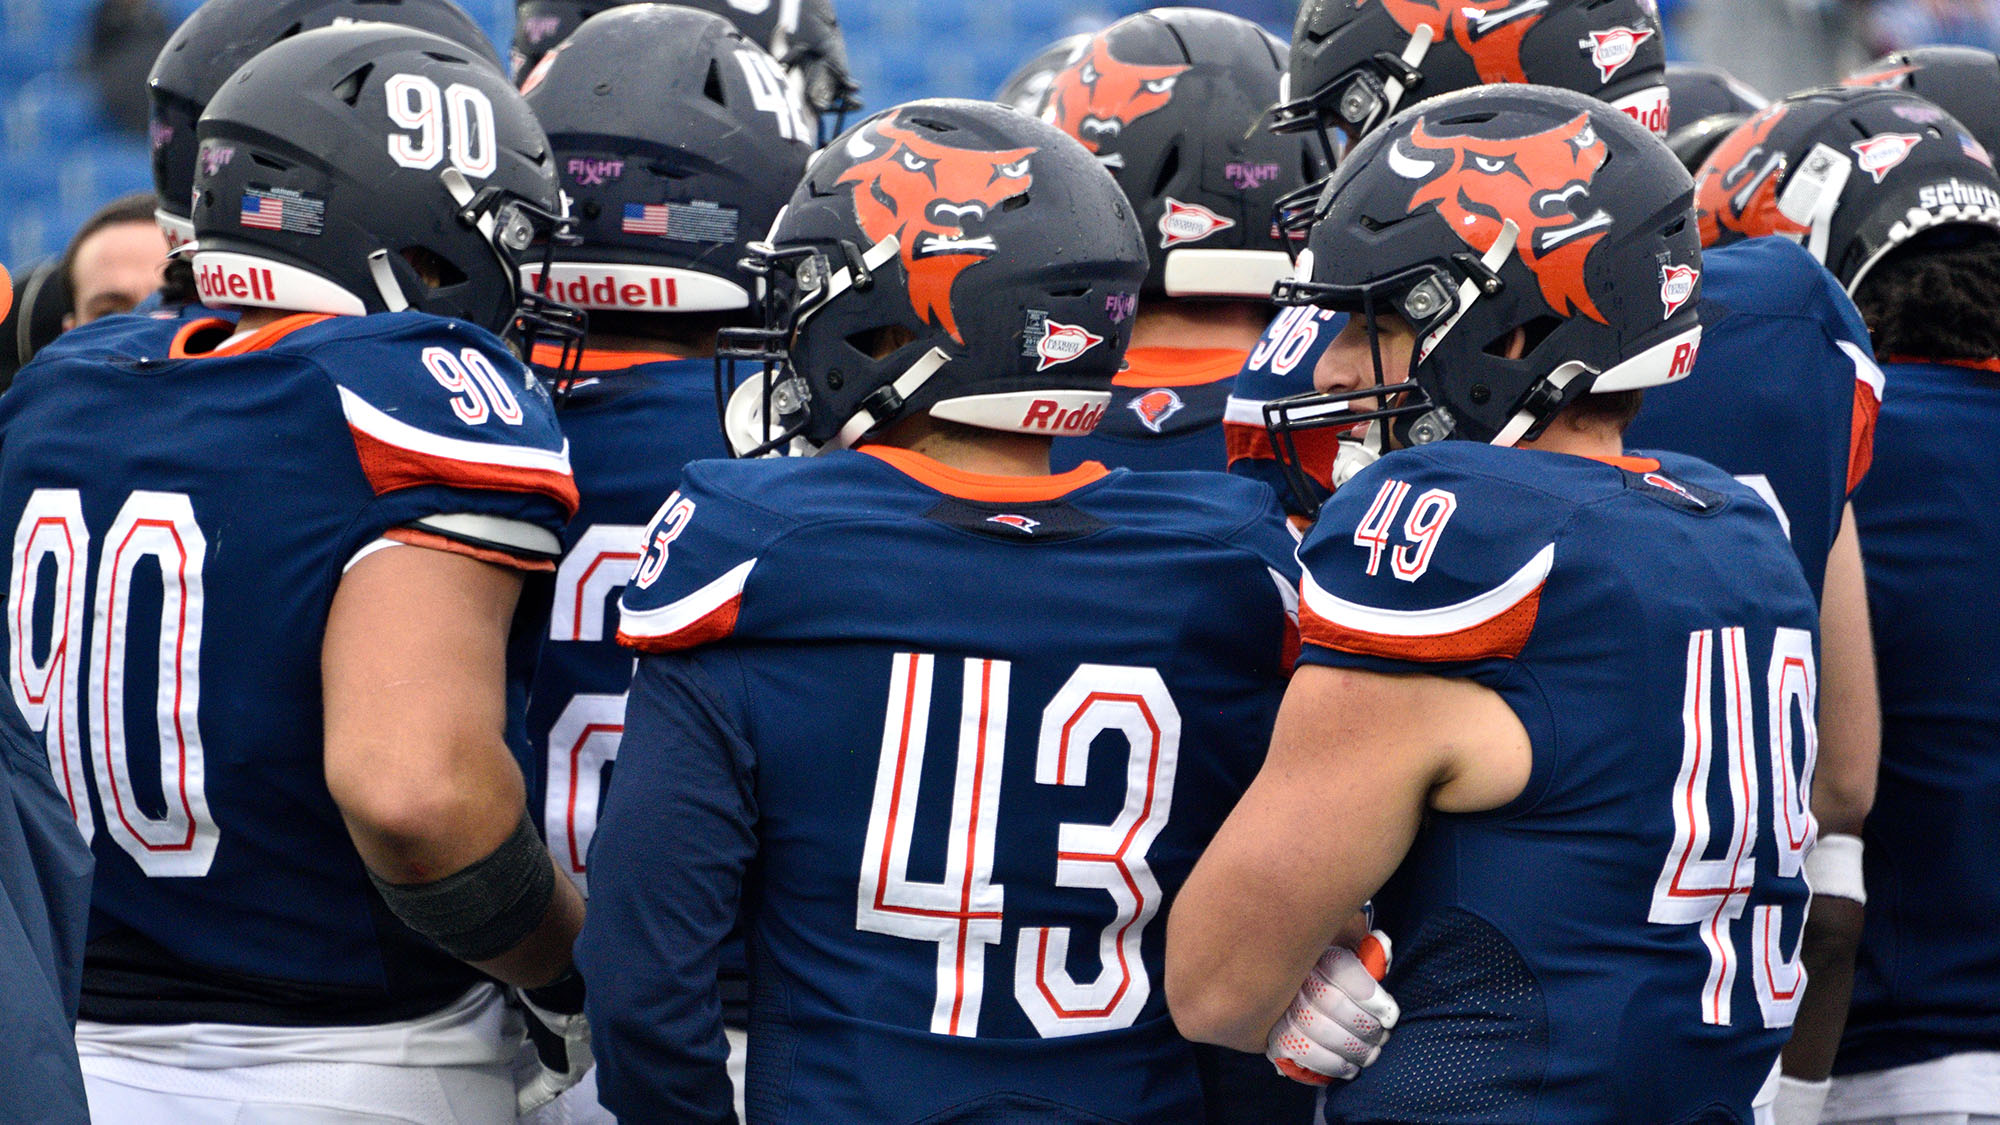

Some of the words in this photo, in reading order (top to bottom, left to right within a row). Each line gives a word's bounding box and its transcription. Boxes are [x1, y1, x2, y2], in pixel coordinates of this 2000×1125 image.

[384, 73, 497, 179] 90
[420, 346, 523, 425] 90
[1048, 338, 1080, 349] PATRIOT
[1248, 304, 1336, 376] 96
[1353, 479, 1457, 582] 49
[8, 489, 220, 877] 90
[857, 653, 1182, 1038] 43
[1648, 627, 1819, 1029] 49
